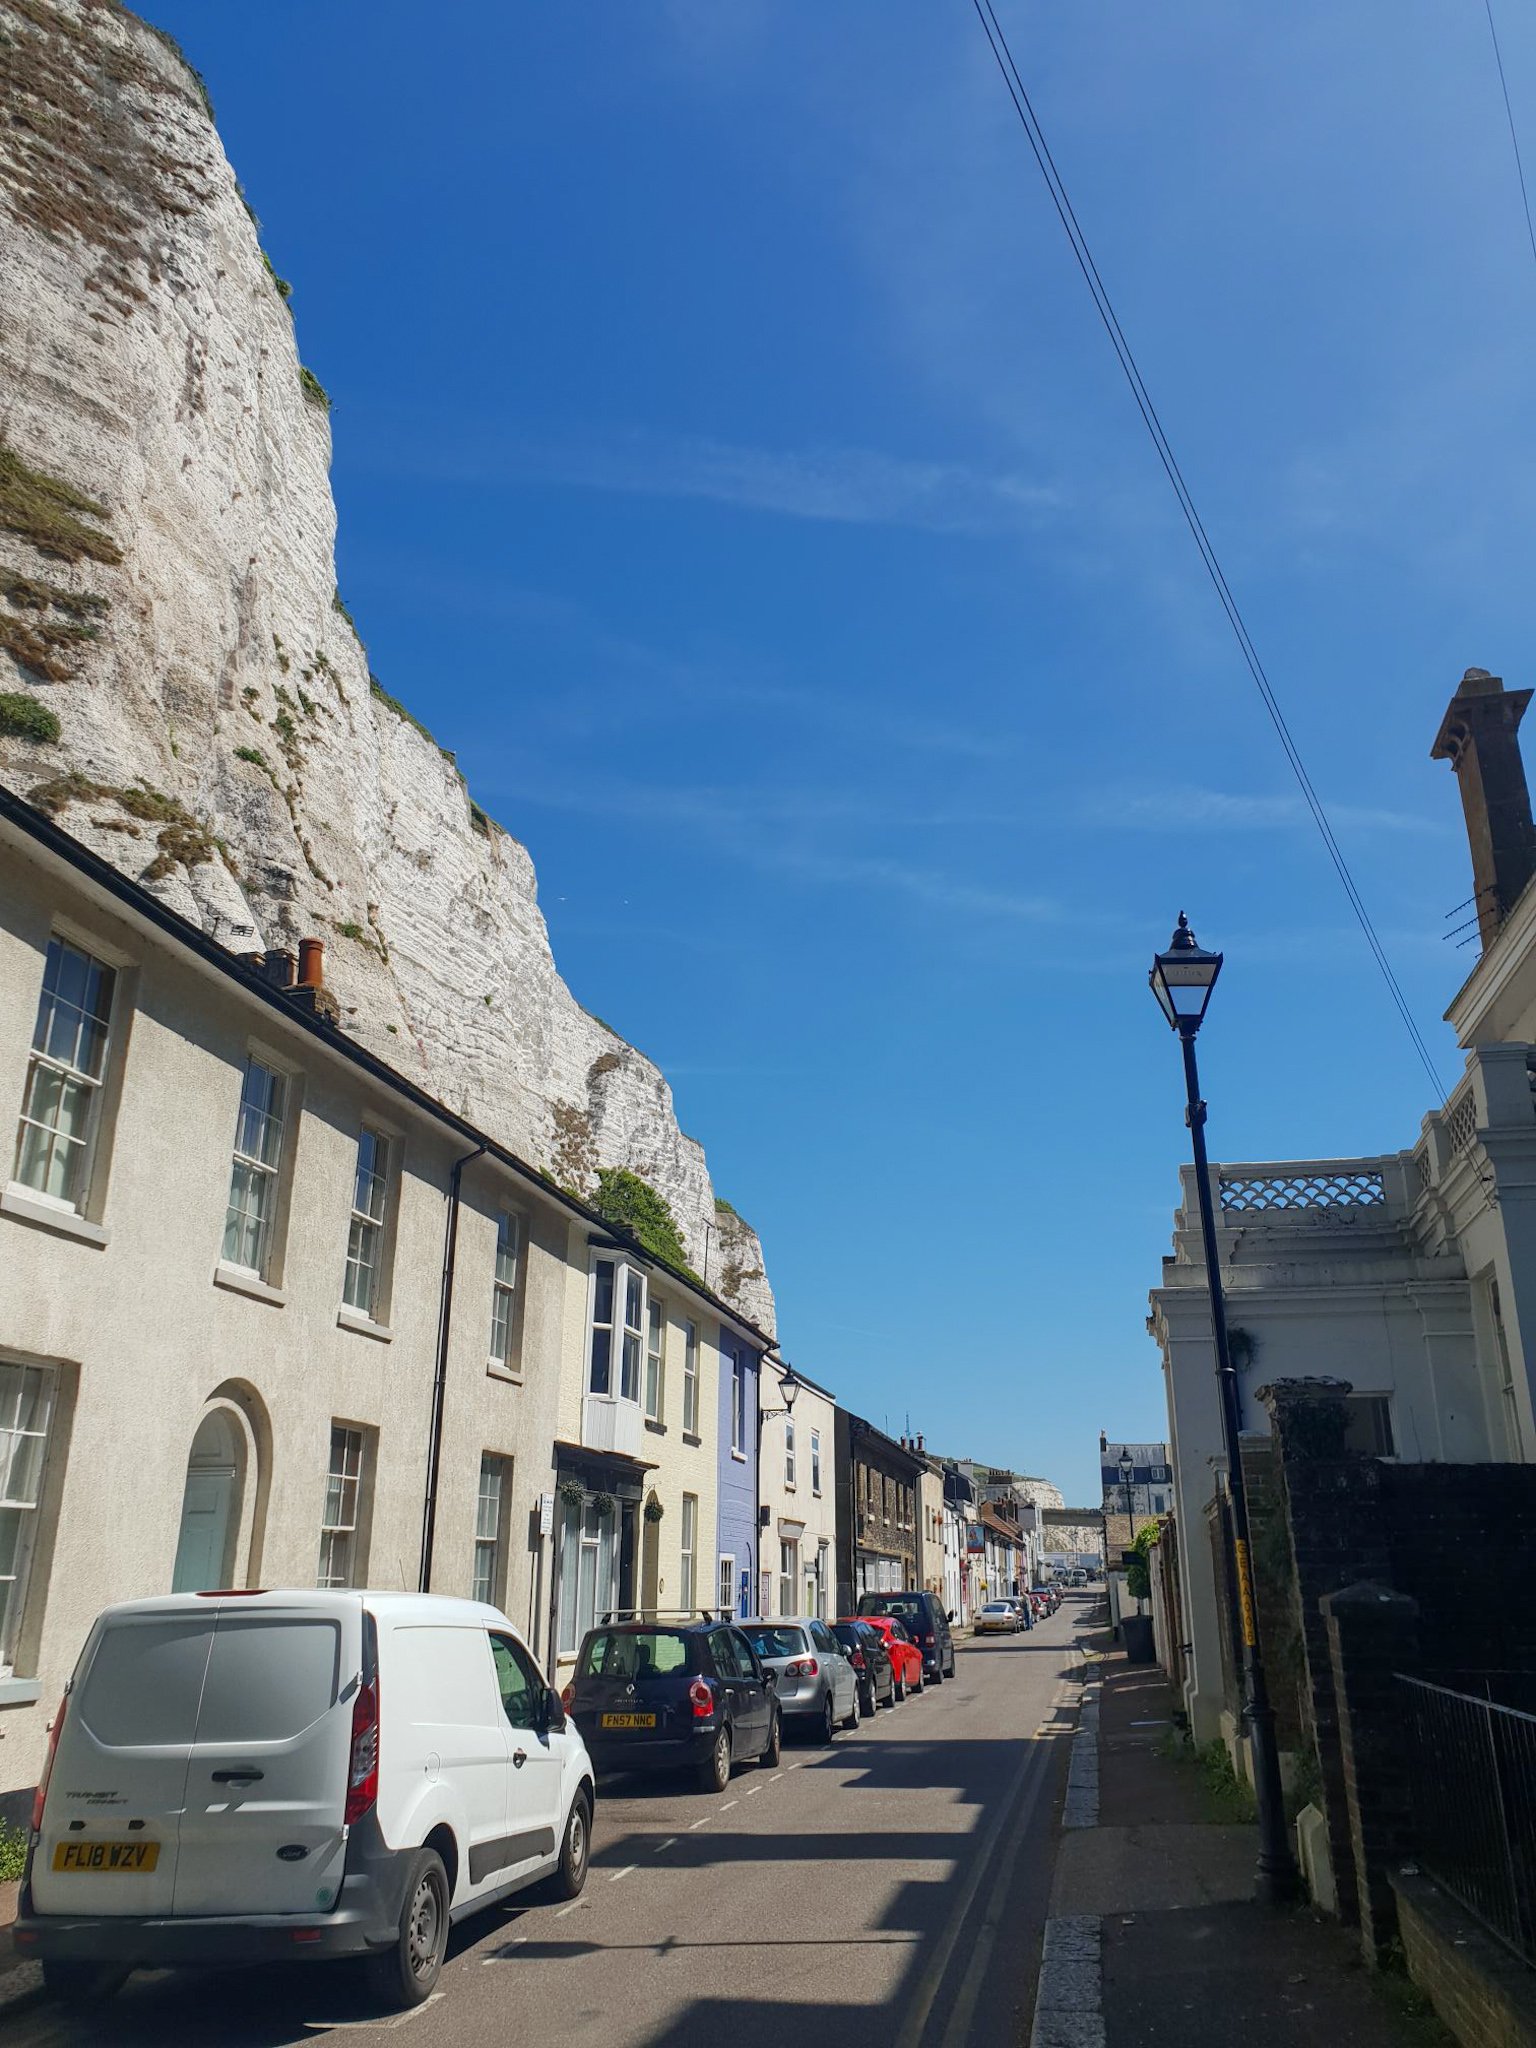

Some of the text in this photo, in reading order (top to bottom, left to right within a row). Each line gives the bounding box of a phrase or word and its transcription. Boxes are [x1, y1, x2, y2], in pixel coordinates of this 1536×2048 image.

[607, 1715, 652, 1726] FN57 NNC
[63, 1845, 147, 1867] FL18 WZV
